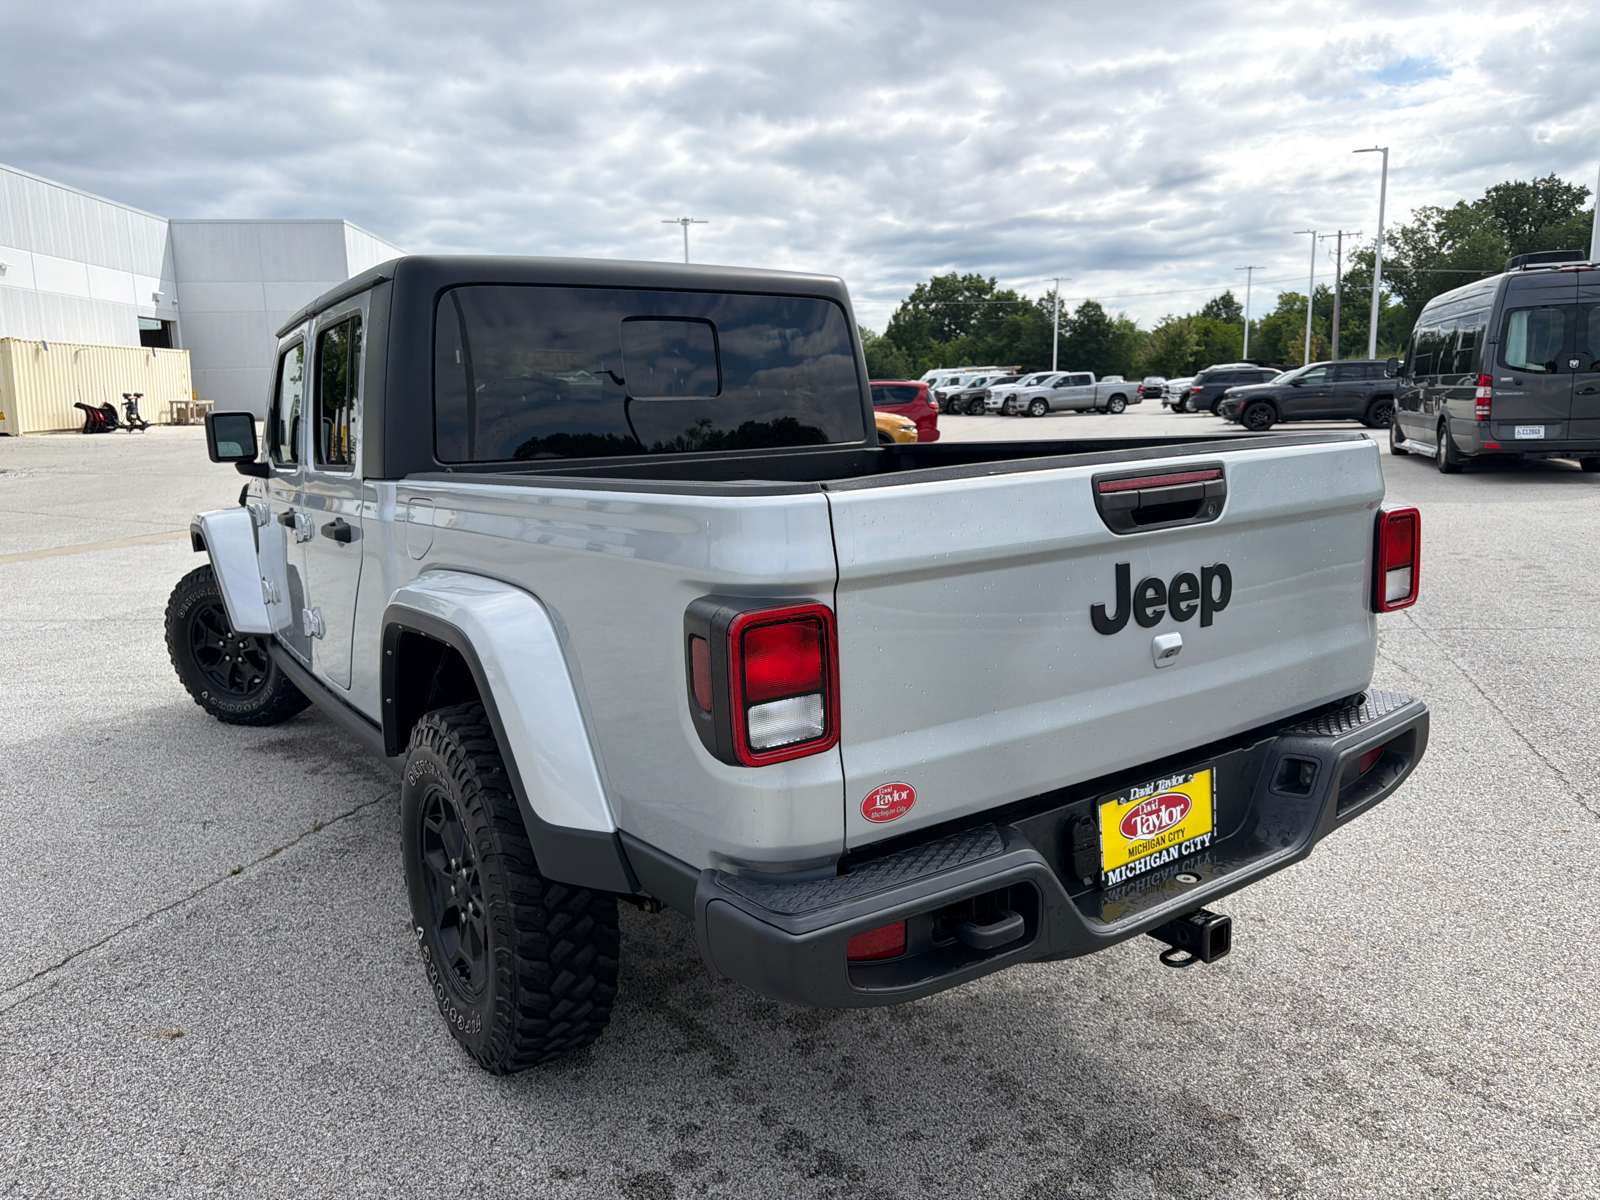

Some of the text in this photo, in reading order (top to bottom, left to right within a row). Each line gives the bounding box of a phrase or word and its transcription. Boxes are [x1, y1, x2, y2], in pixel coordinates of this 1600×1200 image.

[1090, 561, 1233, 636] Jeep
[873, 790, 910, 808] Taylor
[879, 787, 892, 795] David
[1129, 774, 1185, 801] David Taylor
[872, 806, 906, 818] Michigan City
[1131, 802, 1185, 839] Taylor
[1138, 799, 1159, 815] David
[1128, 828, 1186, 858] MICHIGAN CITY
[1107, 833, 1212, 886] MICHIGAN CITY
